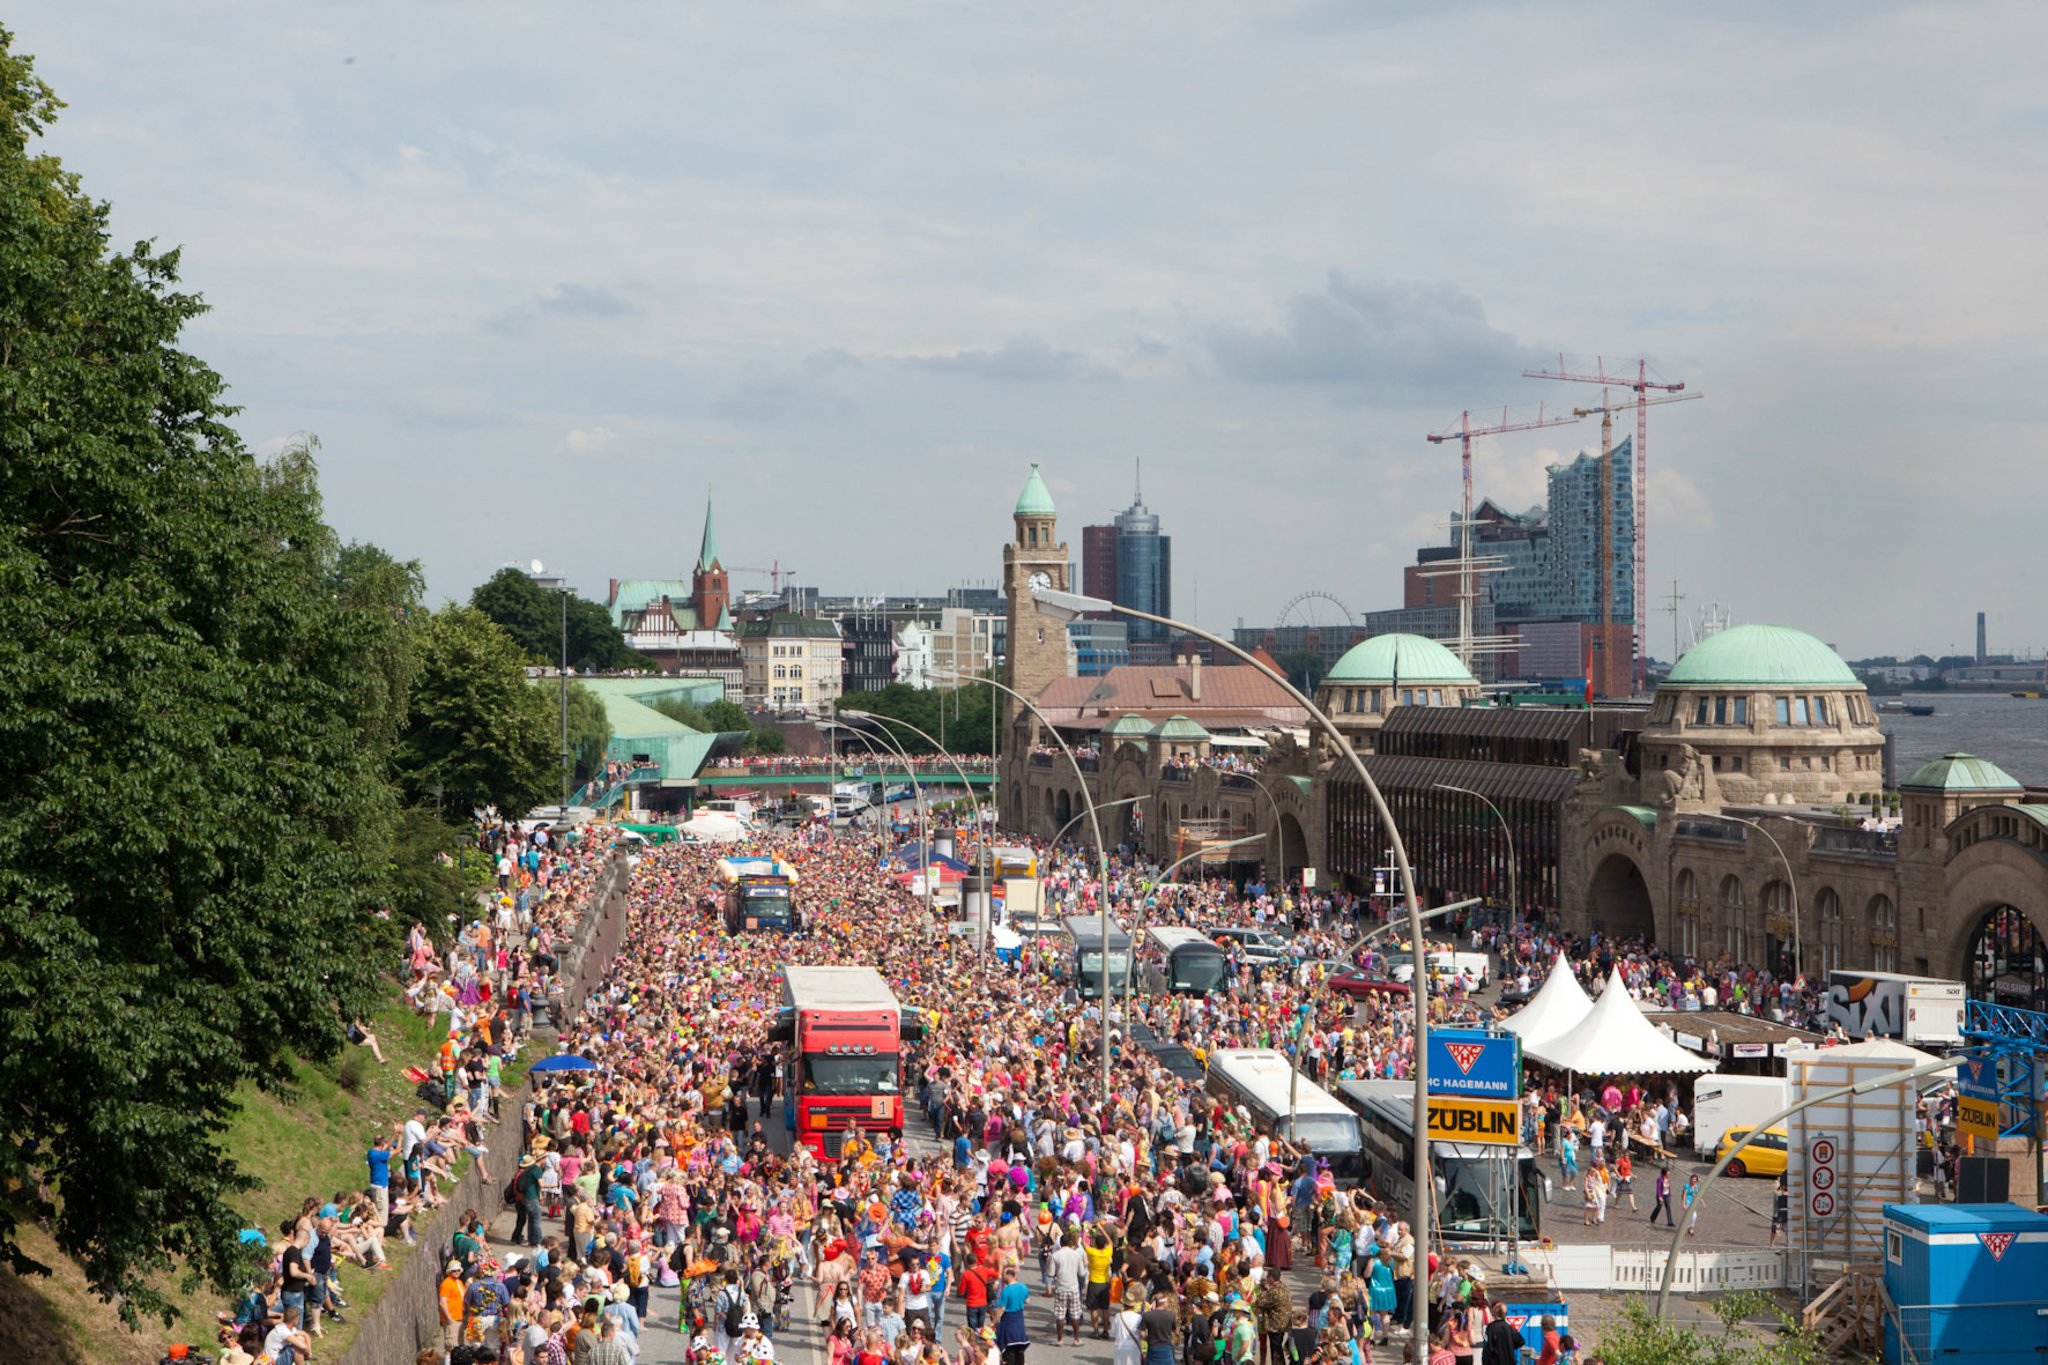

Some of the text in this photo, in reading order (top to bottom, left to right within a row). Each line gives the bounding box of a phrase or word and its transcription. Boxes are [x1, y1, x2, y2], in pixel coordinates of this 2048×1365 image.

[1443, 1079, 1508, 1091] HAGEMANN
[879, 1101, 886, 1115] 1
[1428, 1107, 1515, 1134] ZÜBLIN
